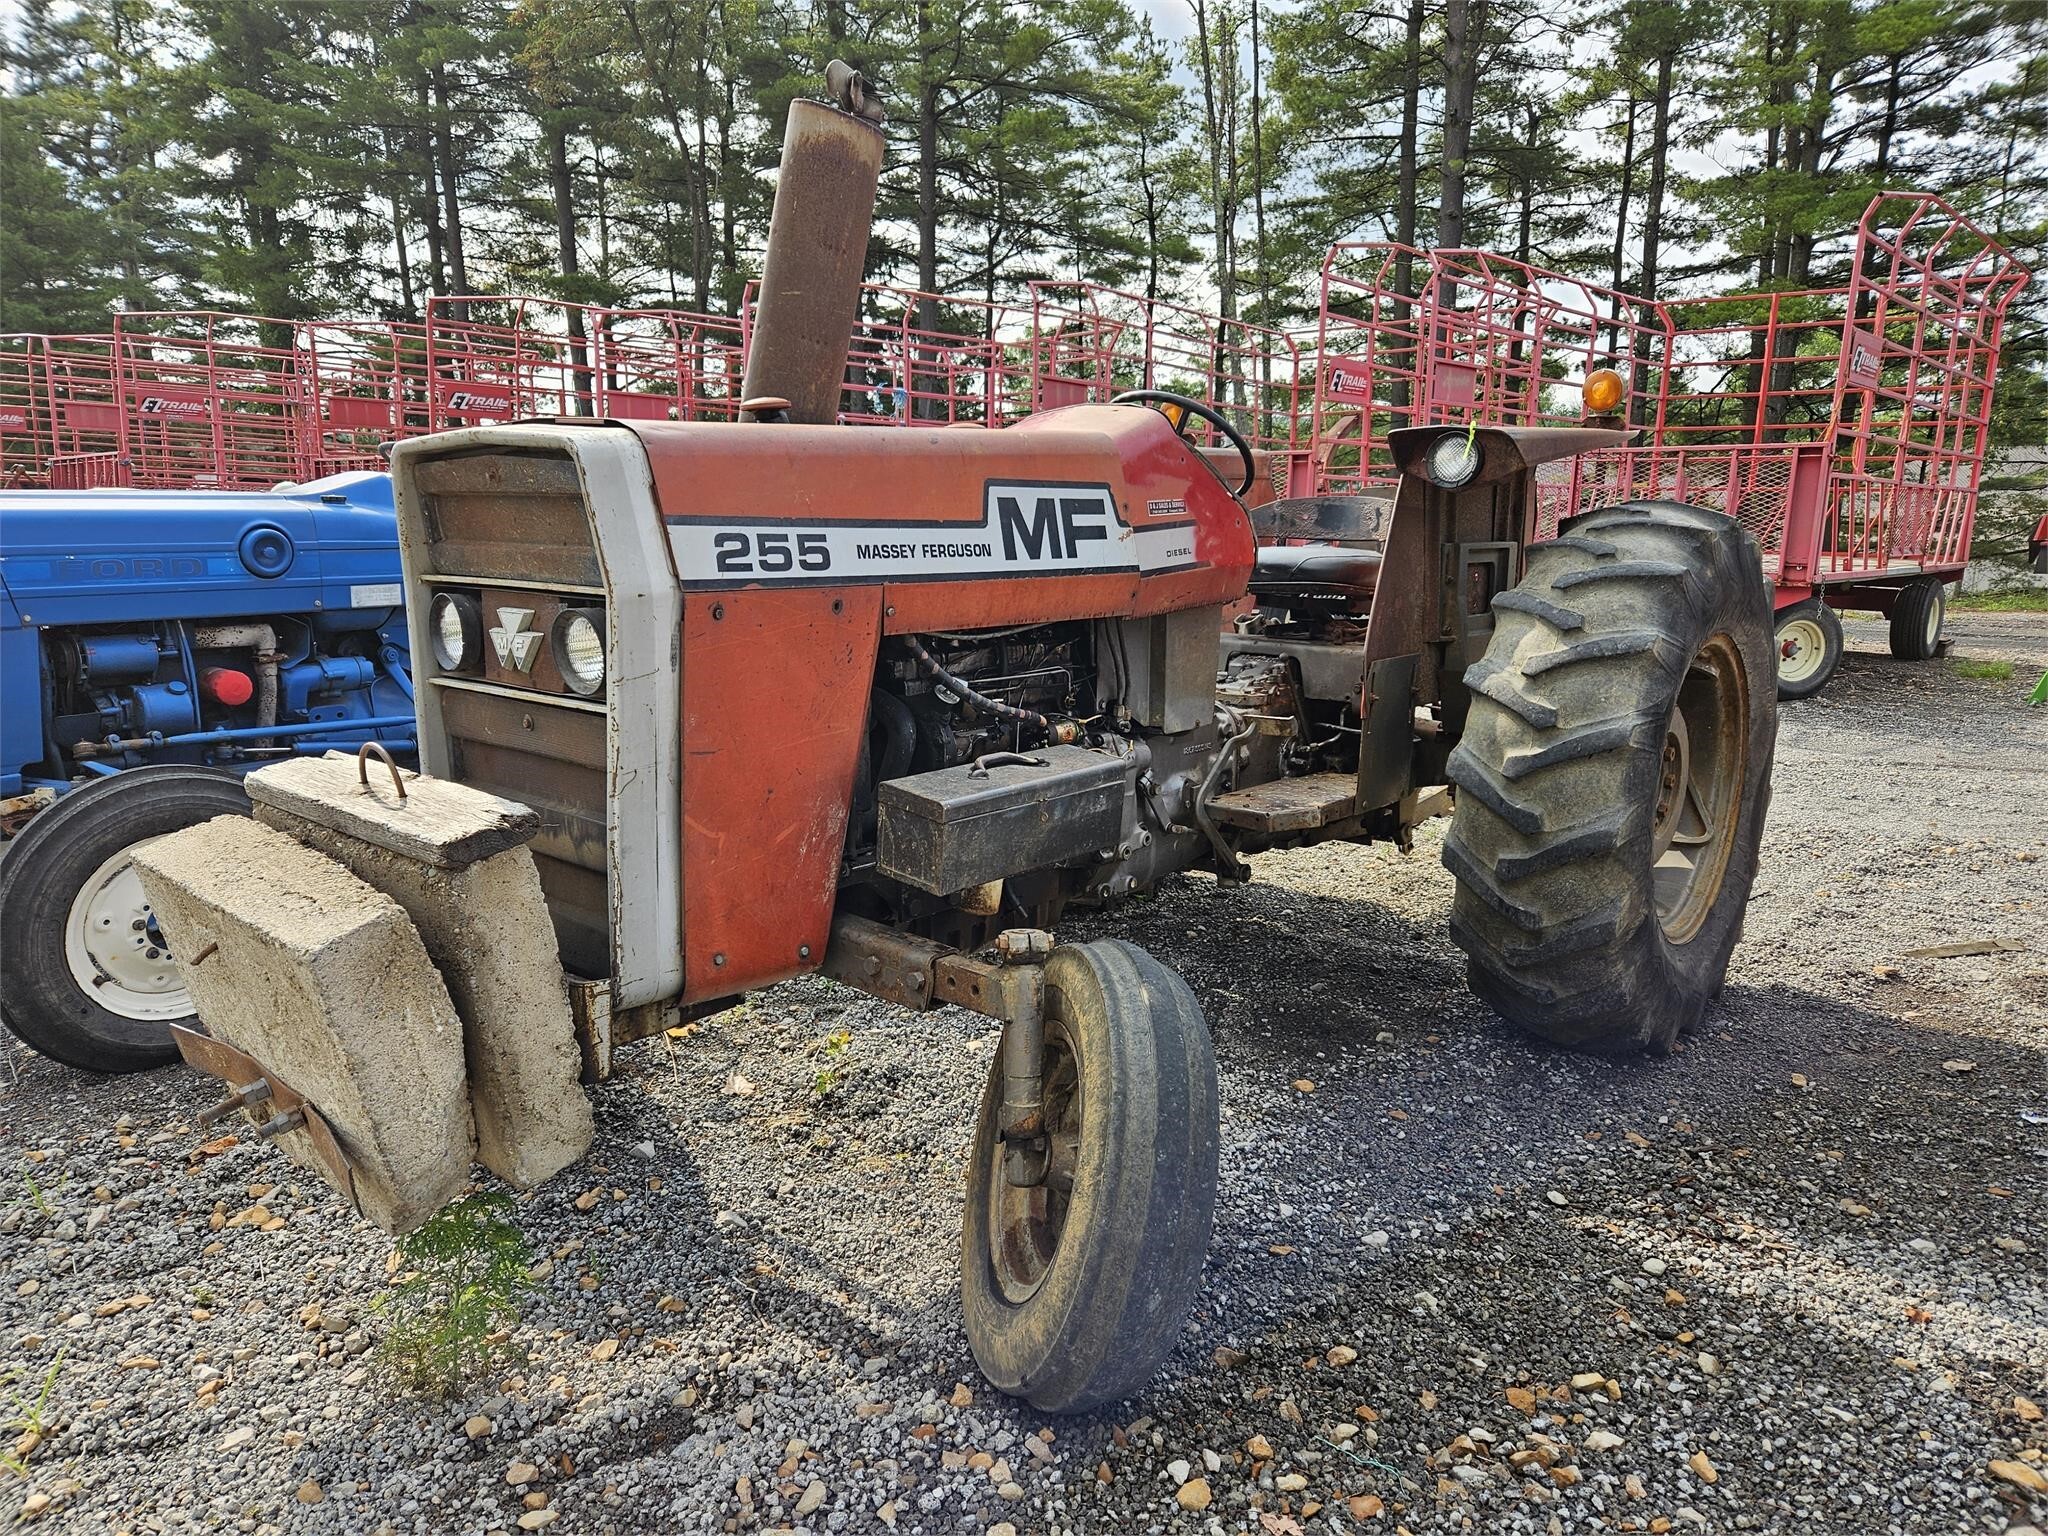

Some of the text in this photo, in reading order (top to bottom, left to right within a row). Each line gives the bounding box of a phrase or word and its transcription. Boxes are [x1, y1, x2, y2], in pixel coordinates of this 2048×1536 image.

[1342, 375, 1367, 388] TRAIL
[161, 401, 203, 411] TRAIL
[469, 396, 509, 408] TRAIL
[996, 496, 1108, 561] MF
[714, 532, 831, 572] 255
[856, 543, 992, 559] MASSEY FERGUSON
[1166, 547, 1192, 557] DIESEL
[56, 558, 204, 578] FORD
